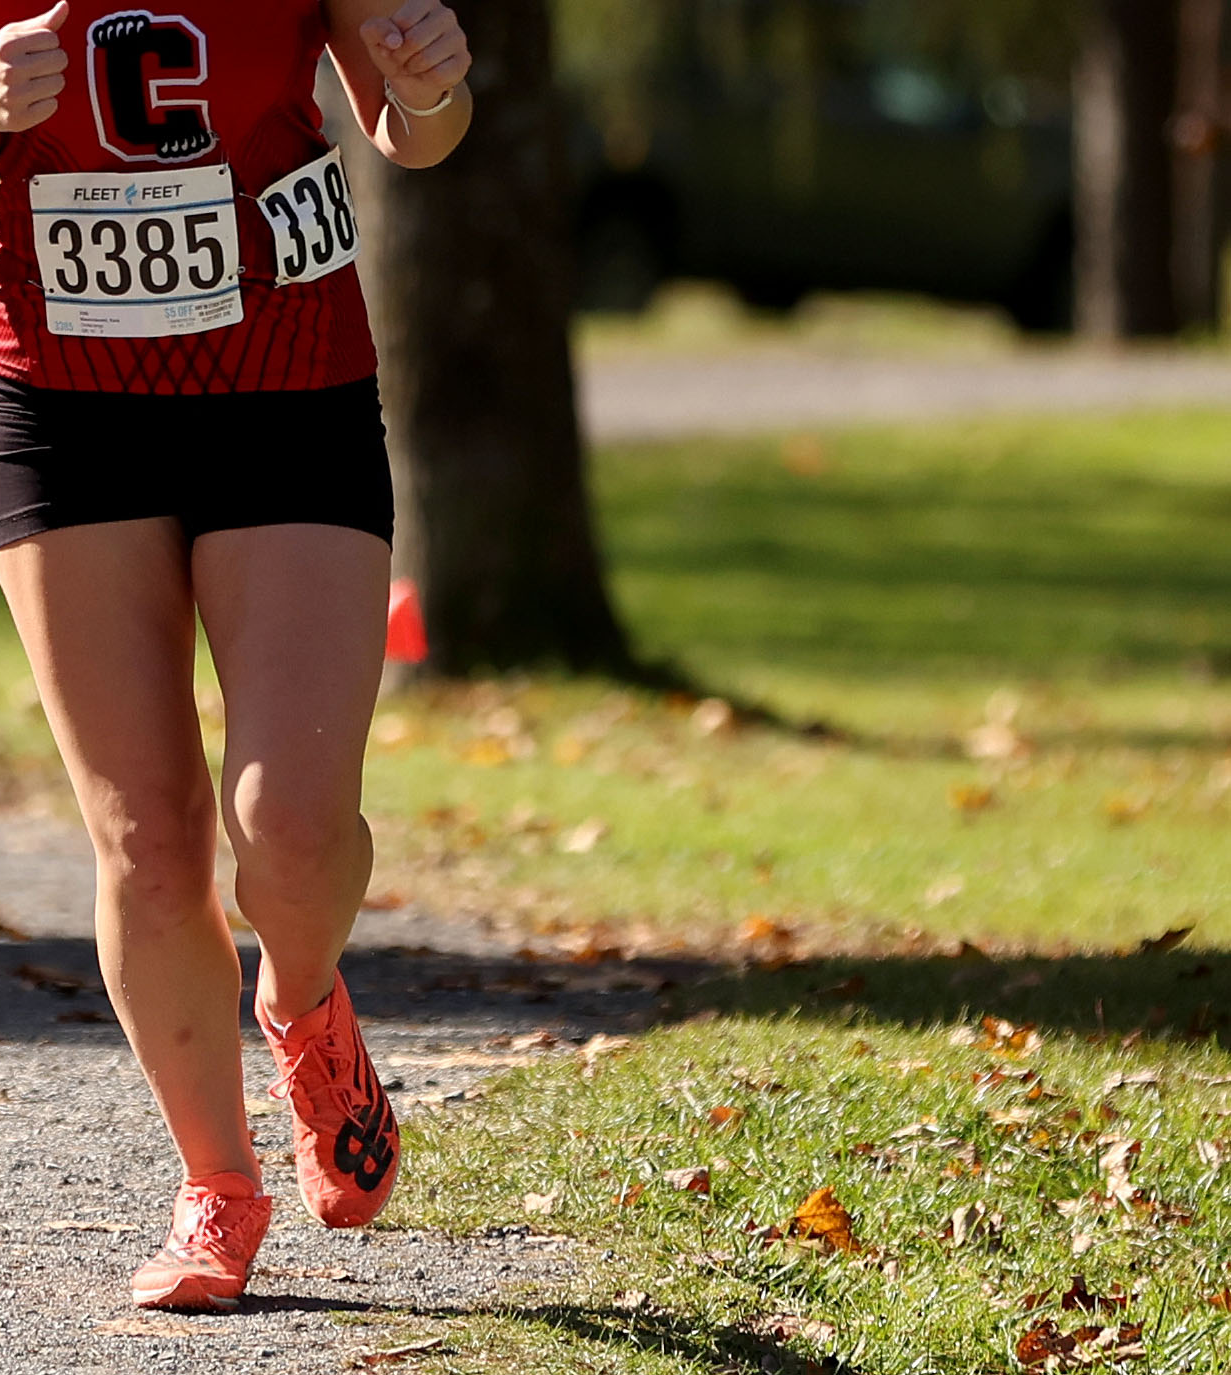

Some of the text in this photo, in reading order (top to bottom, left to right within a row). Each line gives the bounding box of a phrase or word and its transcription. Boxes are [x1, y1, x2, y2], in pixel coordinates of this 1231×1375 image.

[87, 10, 215, 162] C
[73, 184, 183, 201] FLEET FEET
[265, 162, 358, 278] 338
[48, 212, 225, 296] 3385
